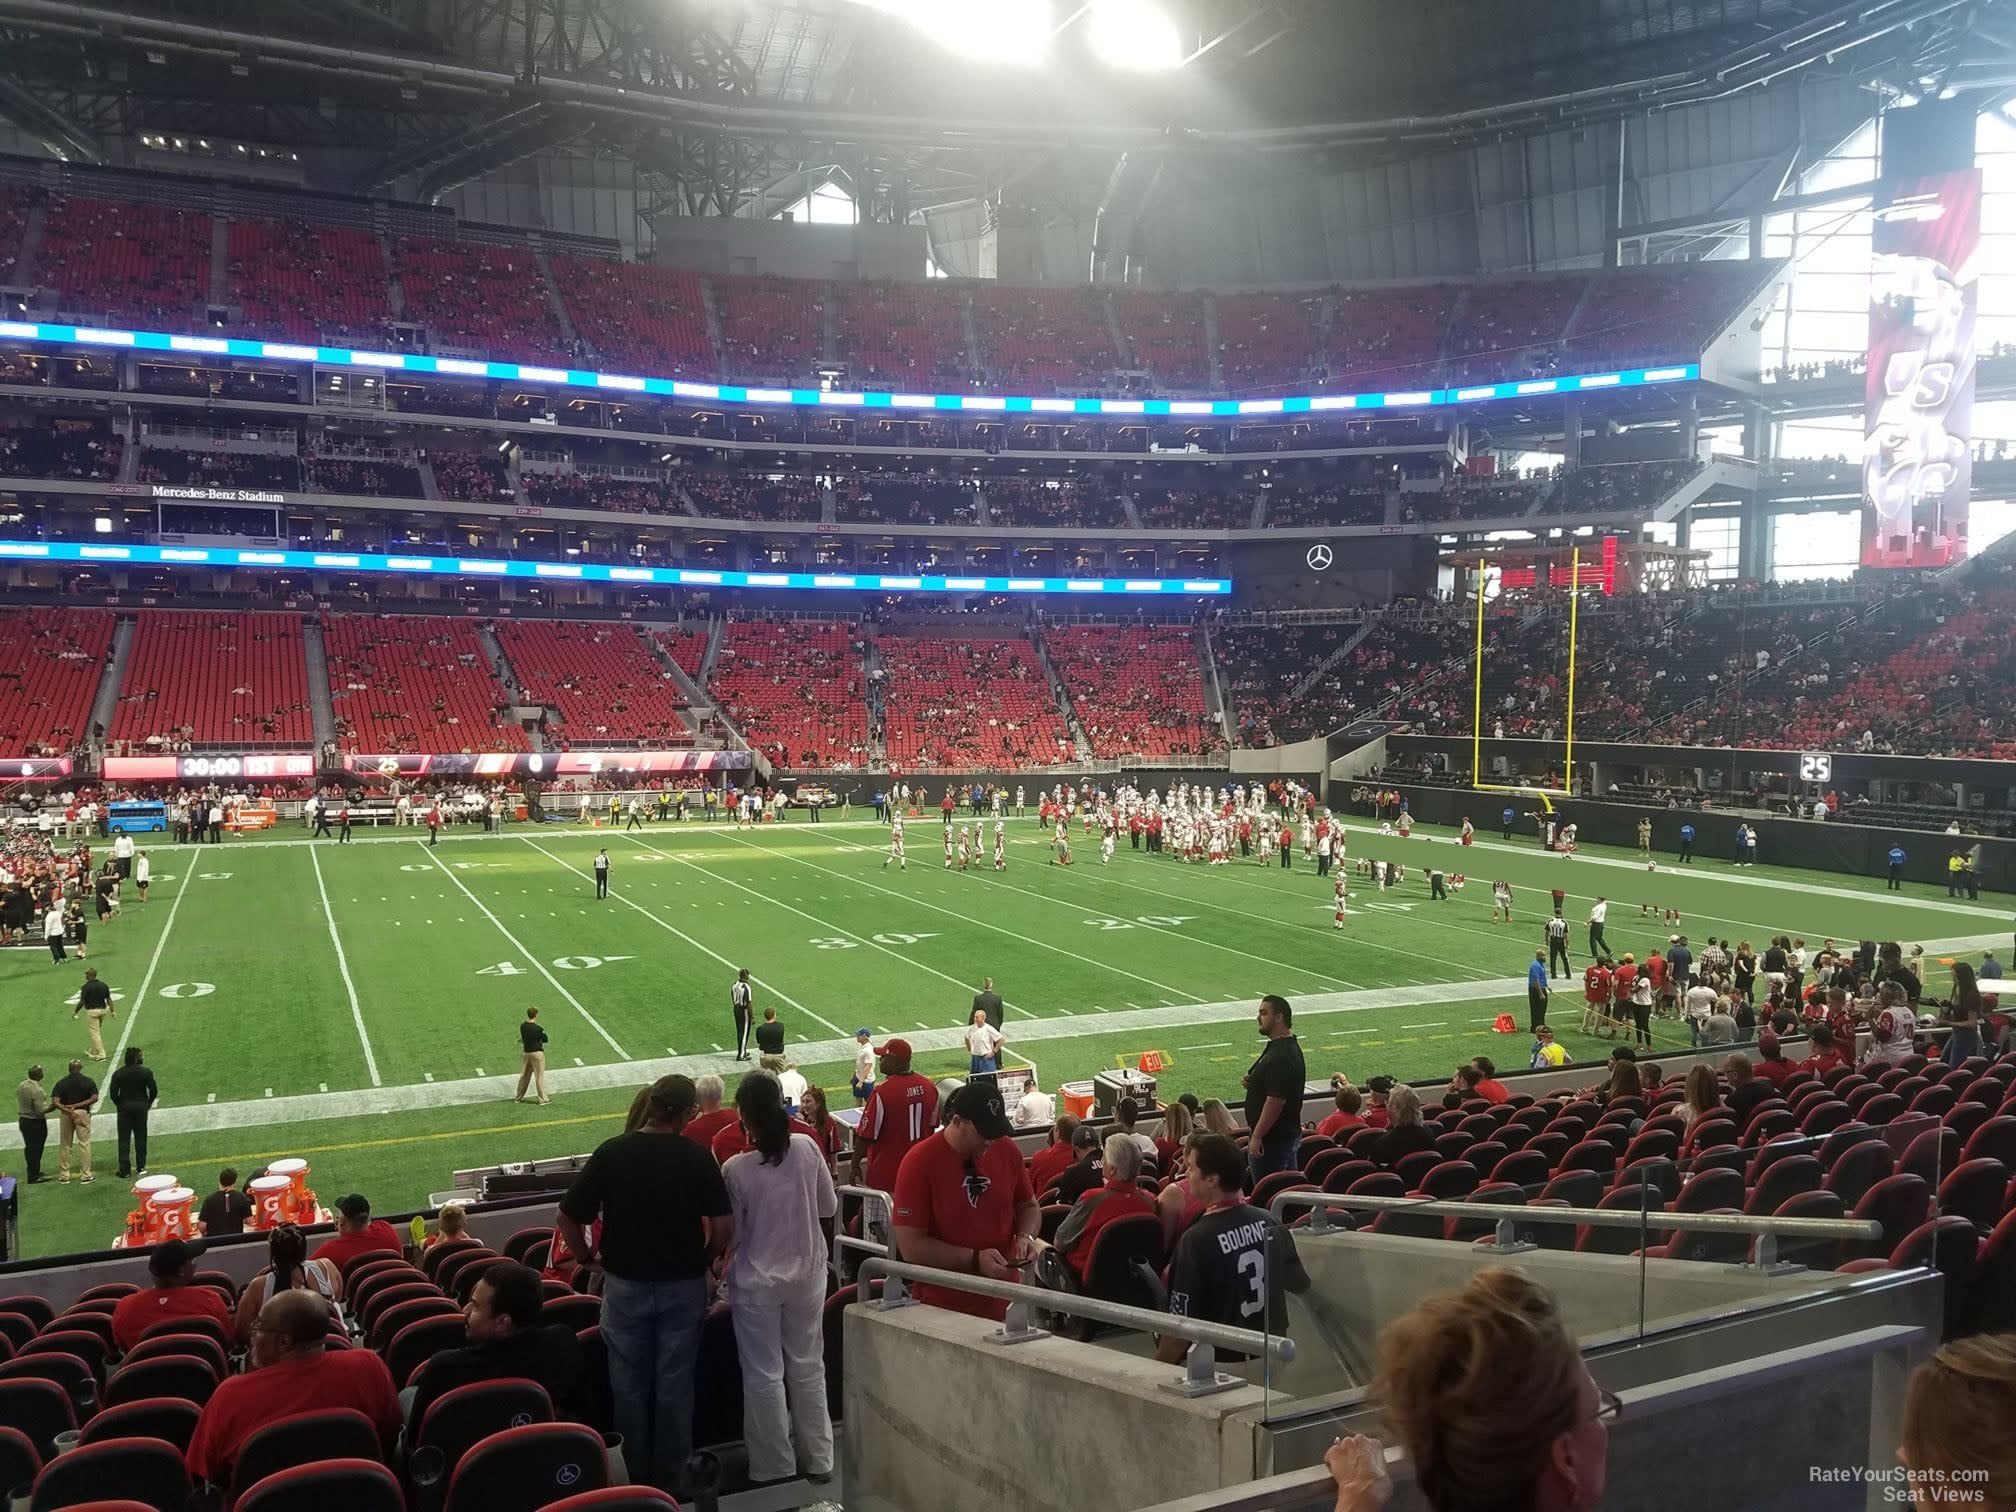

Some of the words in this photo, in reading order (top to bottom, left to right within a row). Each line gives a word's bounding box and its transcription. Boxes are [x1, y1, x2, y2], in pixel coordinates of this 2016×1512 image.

[152, 485, 236, 500] Mercedes-Benz
[238, 491, 284, 503] Stadium
[183, 757, 240, 775] 30:00
[378, 757, 399, 771] 25
[528, 754, 543, 772] 0
[1802, 756, 1829, 780] 25
[809, 932, 918, 949] 30
[475, 955, 603, 976] 40
[1590, 976, 1599, 989] 2
[1502, 1015, 1515, 1030] 20
[1145, 1051, 1162, 1070] 30
[905, 1085, 924, 1098] JONES
[908, 1102, 923, 1142] 11
[263, 1196, 279, 1212] G
[163, 1209, 180, 1226] G
[1217, 1220, 1274, 1255] BOURNE
[1237, 1249, 1266, 1318] 3
